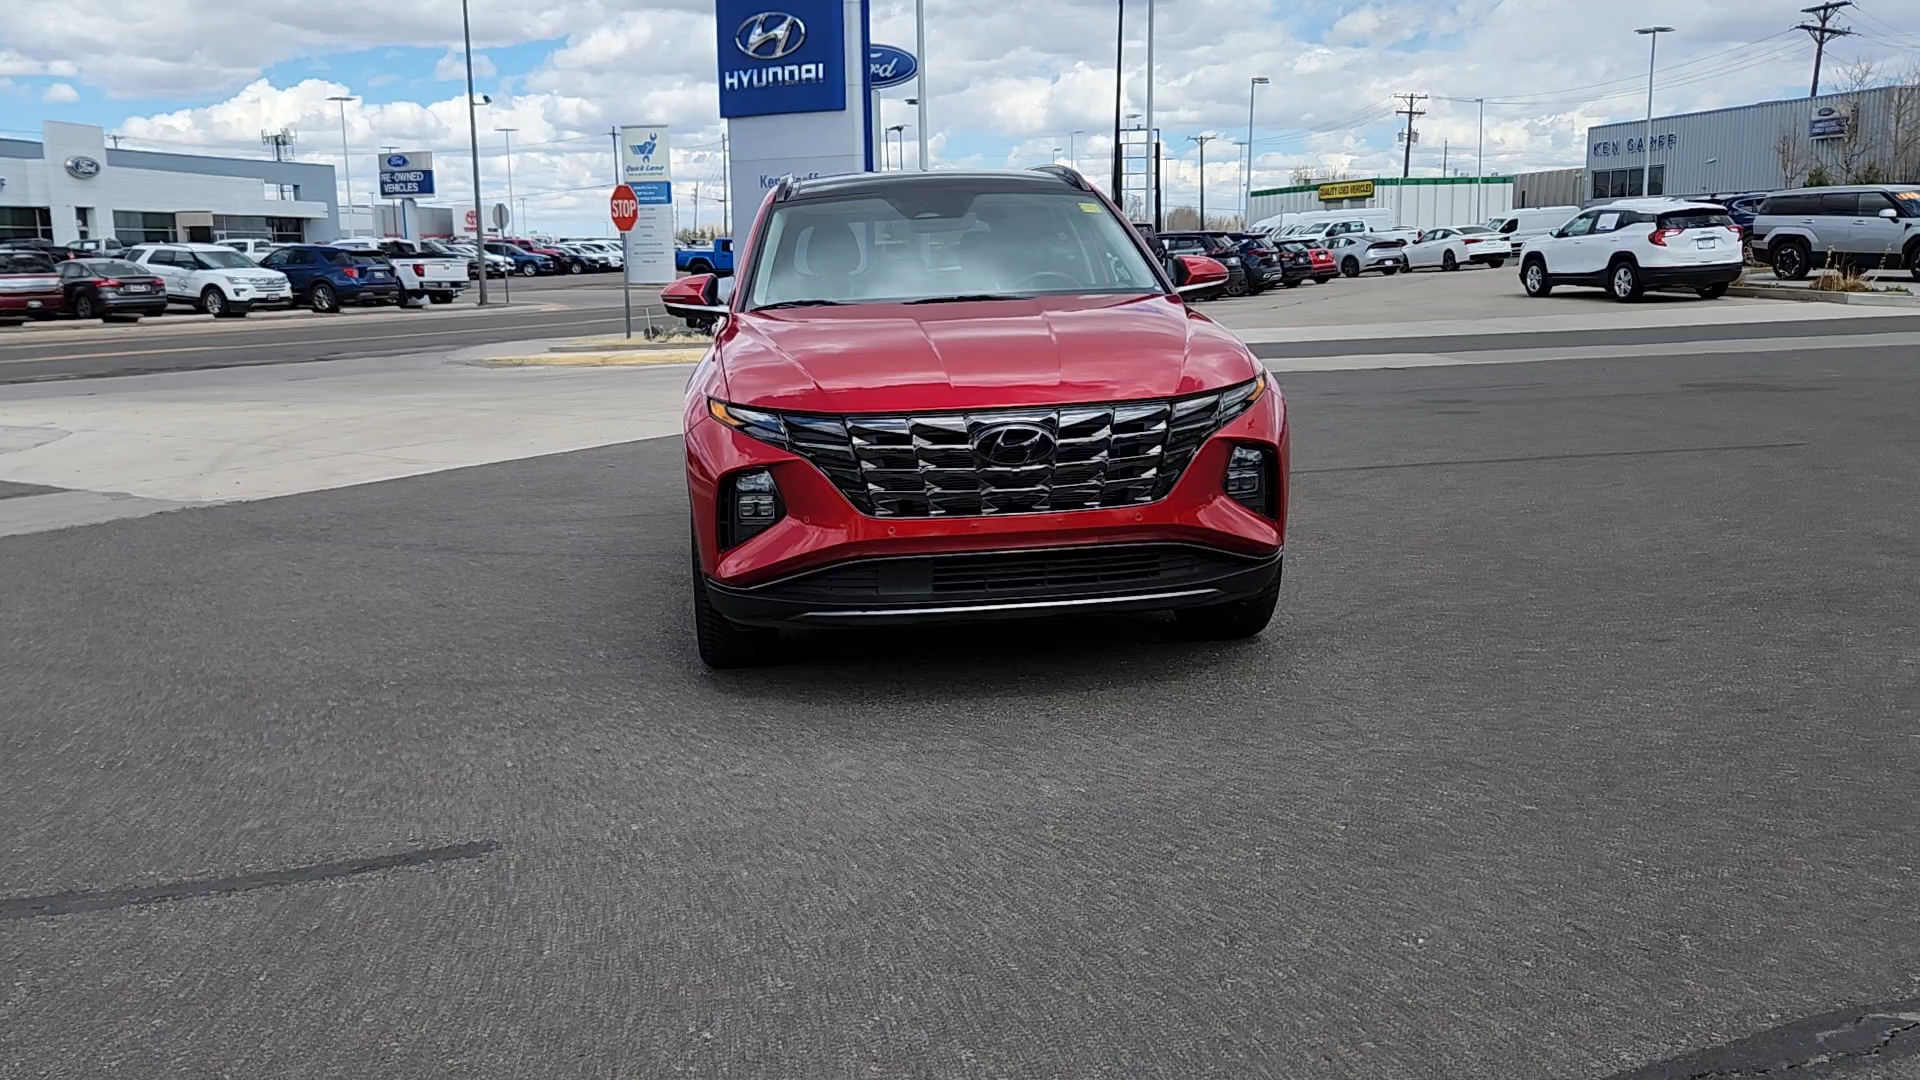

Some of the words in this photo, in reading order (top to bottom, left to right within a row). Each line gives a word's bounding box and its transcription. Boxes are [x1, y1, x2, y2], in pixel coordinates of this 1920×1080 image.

[870, 52, 898, 77] rd
[725, 63, 824, 91] HYUNDAI
[1593, 141, 1620, 156] KEN
[626, 164, 644, 172] Quick
[380, 171, 424, 182] PRE-OWNED
[383, 183, 419, 192] VEHICLES
[1320, 186, 1338, 197] QUALITY
[1338, 185, 1349, 195] USED
[1350, 183, 1372, 194] VEHICLES
[612, 200, 637, 218] STOP
